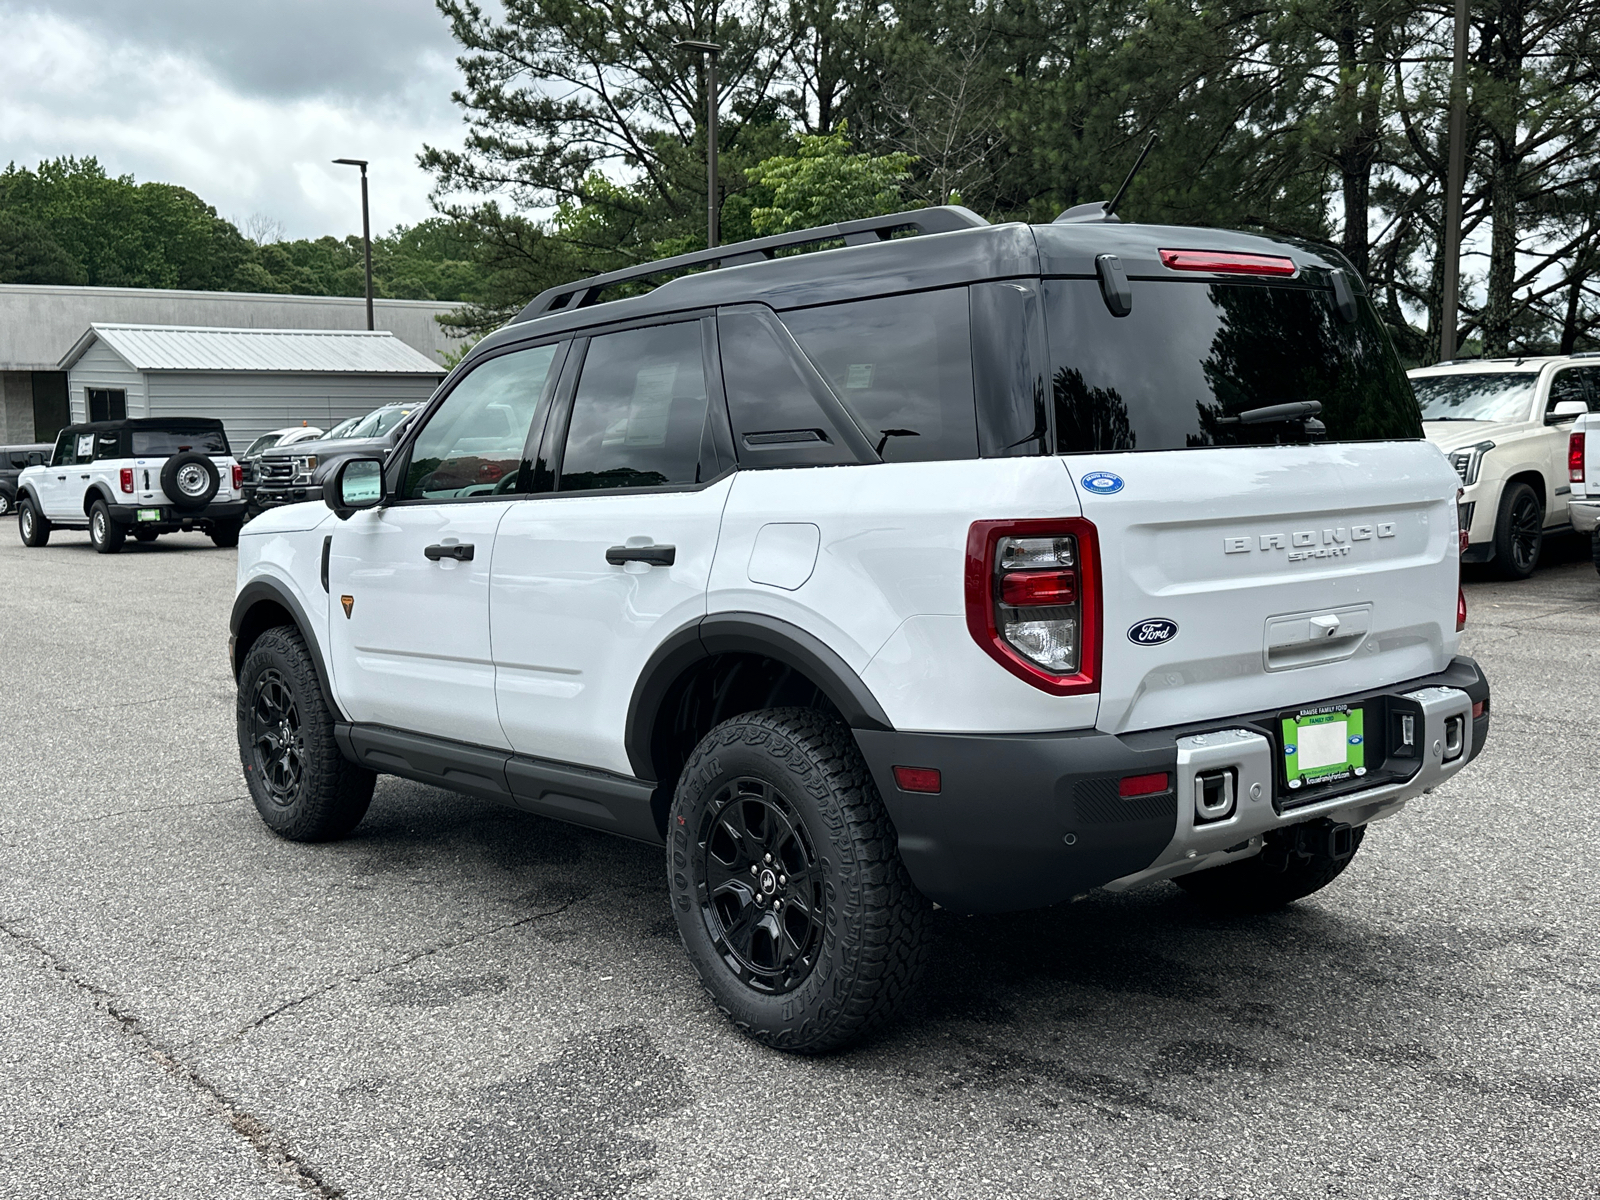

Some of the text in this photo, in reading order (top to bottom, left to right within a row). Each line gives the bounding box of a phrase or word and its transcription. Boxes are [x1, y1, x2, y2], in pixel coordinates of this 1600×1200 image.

[1224, 522, 1396, 554] BRONCO
[1288, 545, 1351, 561] SPORT
[1138, 623, 1170, 641] Ford
[1318, 706, 1335, 714] FAMILY
